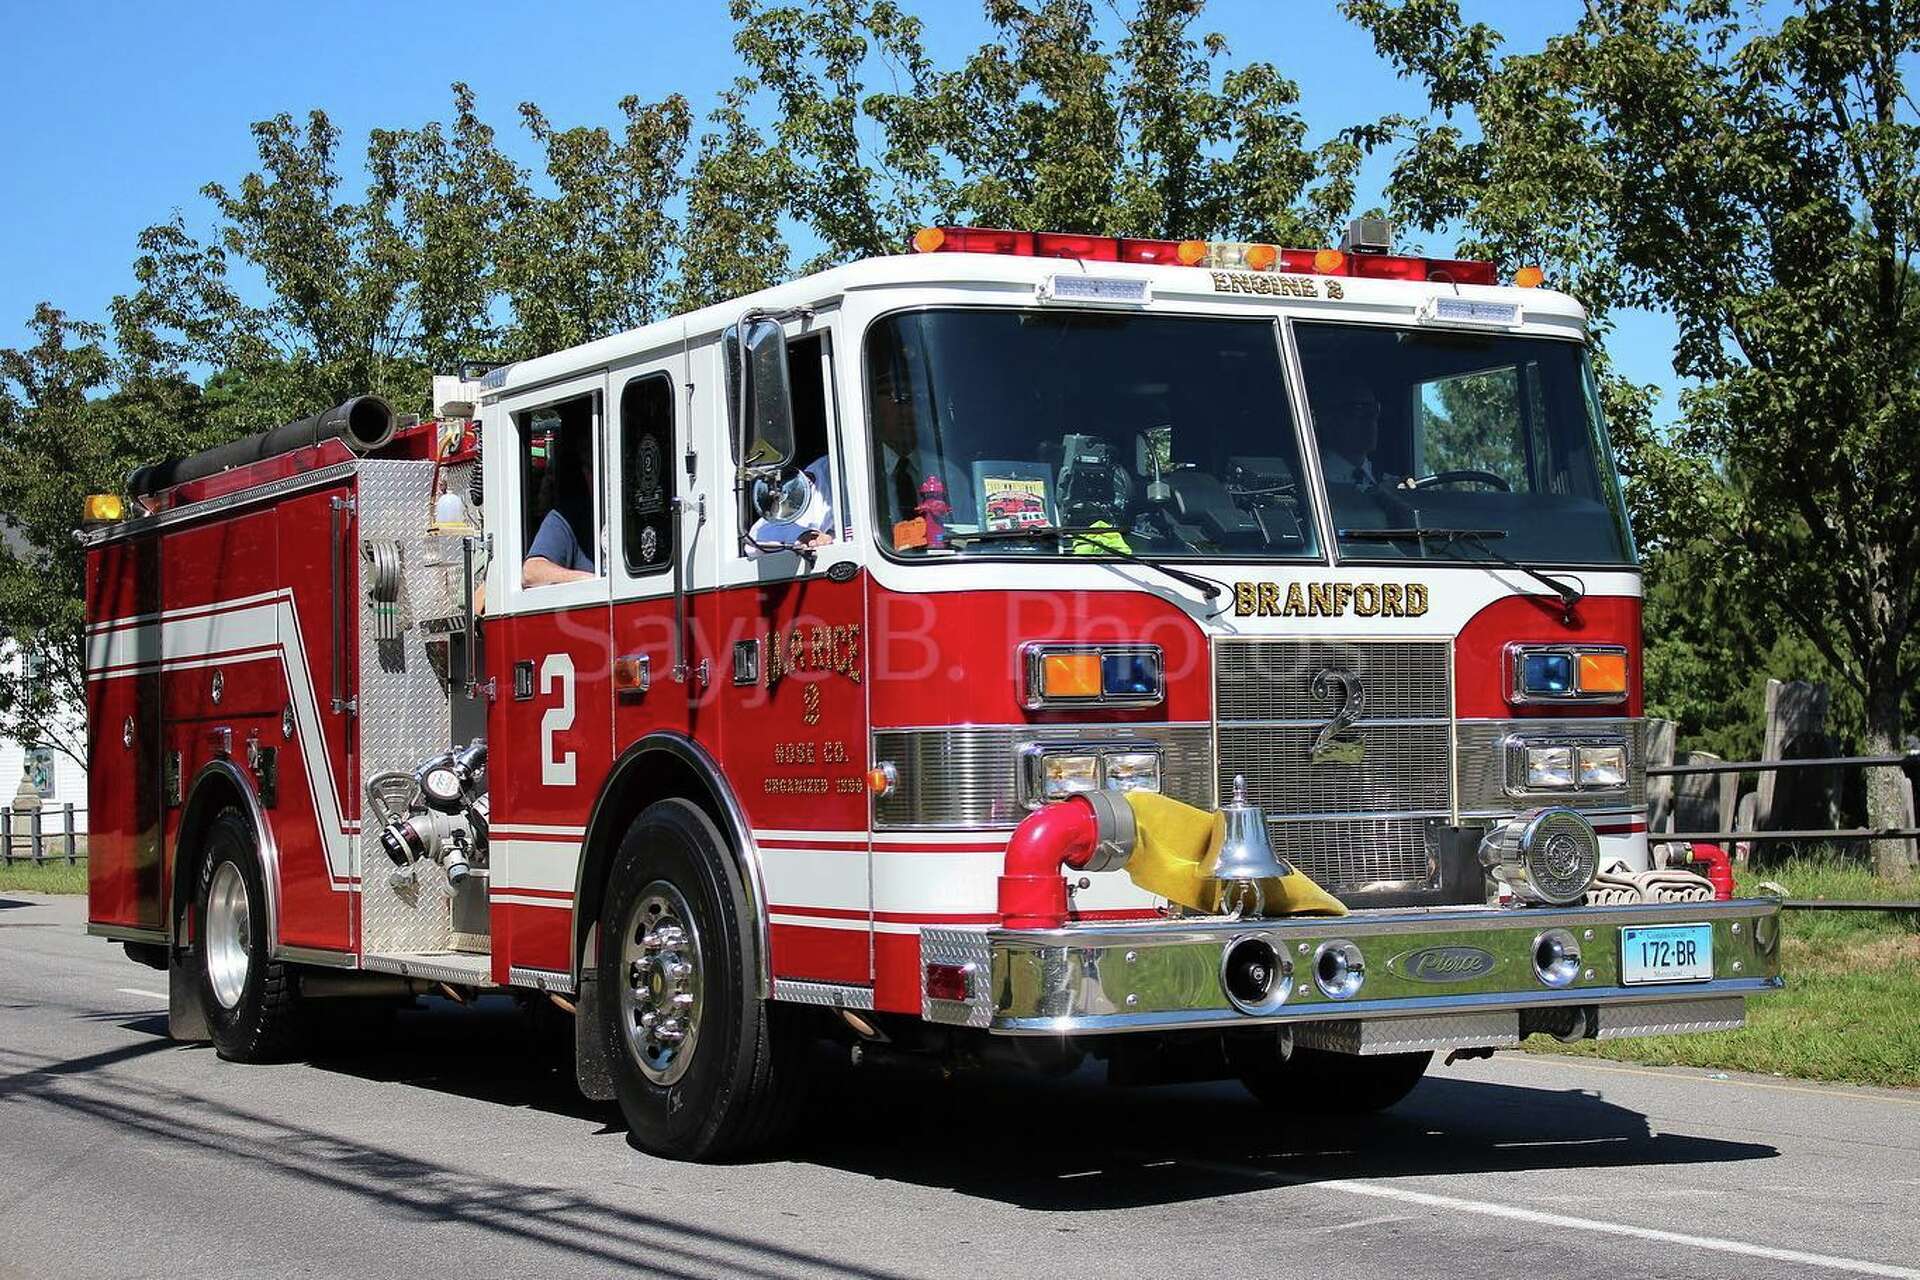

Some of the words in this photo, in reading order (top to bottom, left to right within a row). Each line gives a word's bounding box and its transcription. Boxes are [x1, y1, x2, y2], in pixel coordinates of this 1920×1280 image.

[1210, 271, 1318, 298] ENGINE
[1234, 581, 1429, 618] BRANFORD
[811, 623, 862, 684] RICE
[540, 652, 577, 787] 2
[803, 682, 820, 725] 2
[1310, 666, 1367, 766] 2
[775, 742, 816, 764] HOSE
[823, 740, 850, 763] CO.
